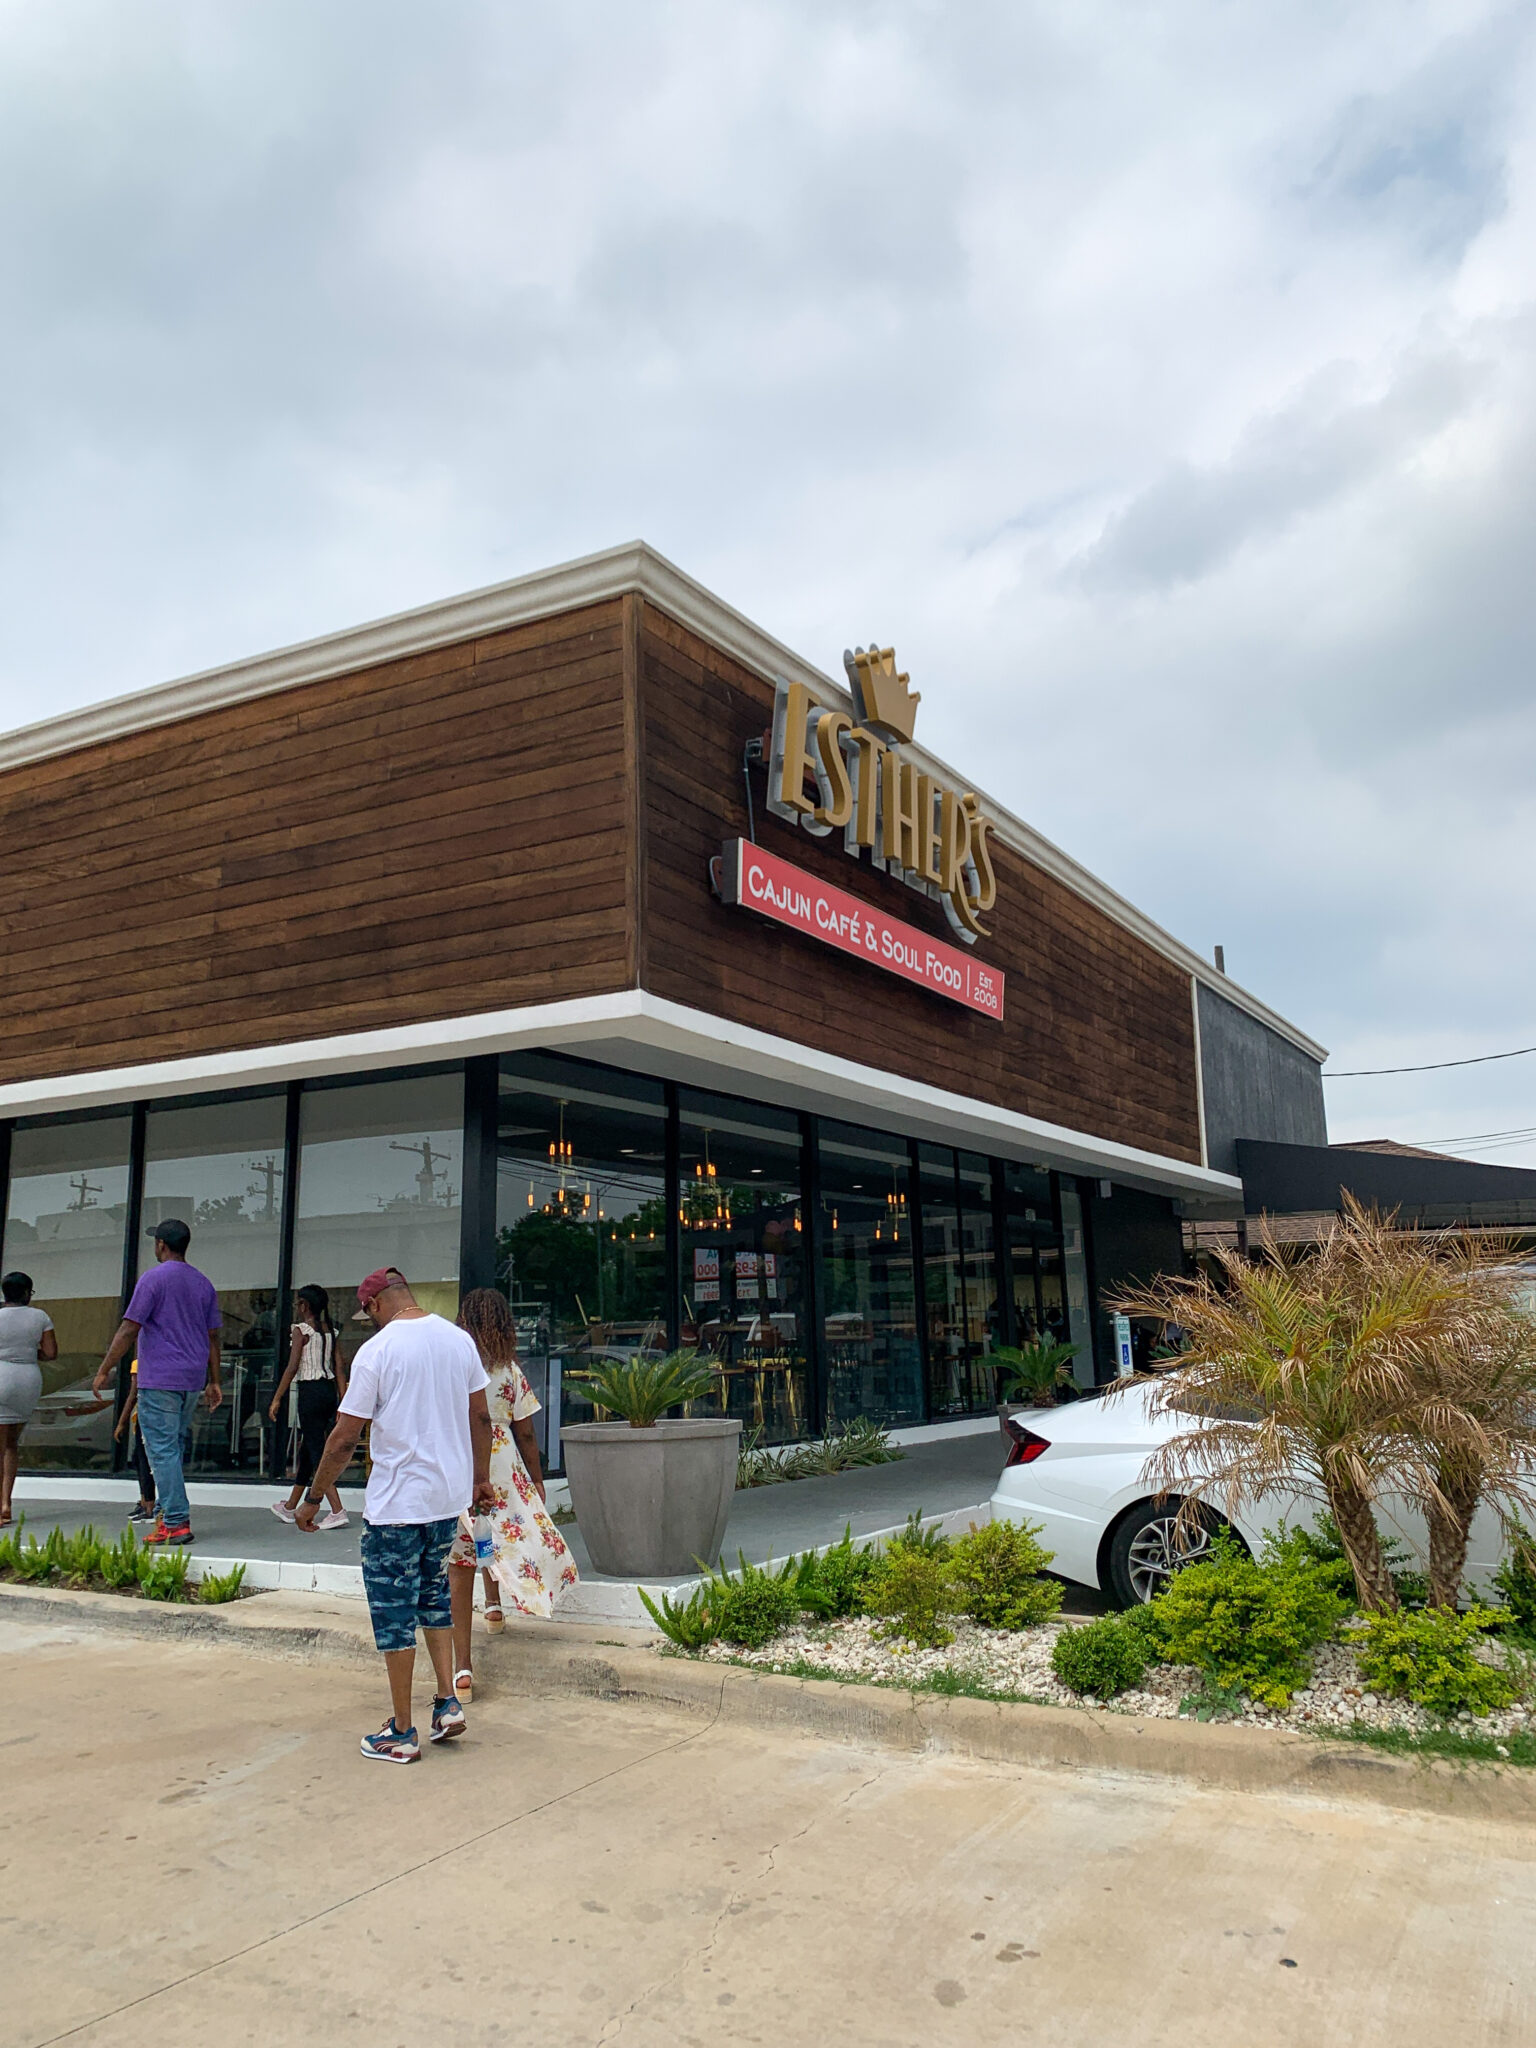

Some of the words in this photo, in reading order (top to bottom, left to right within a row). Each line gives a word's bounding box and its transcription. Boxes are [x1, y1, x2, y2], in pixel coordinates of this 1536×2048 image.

[781, 682, 995, 936] ESTHER'S
[748, 865, 811, 921] CAJUN
[815, 898, 861, 945] CAFÉ
[864, 920, 879, 953] &
[881, 930, 923, 974] SOUL
[925, 951, 962, 990] FOOD
[974, 987, 998, 1009] 2008
[979, 971, 993, 991] EST.
